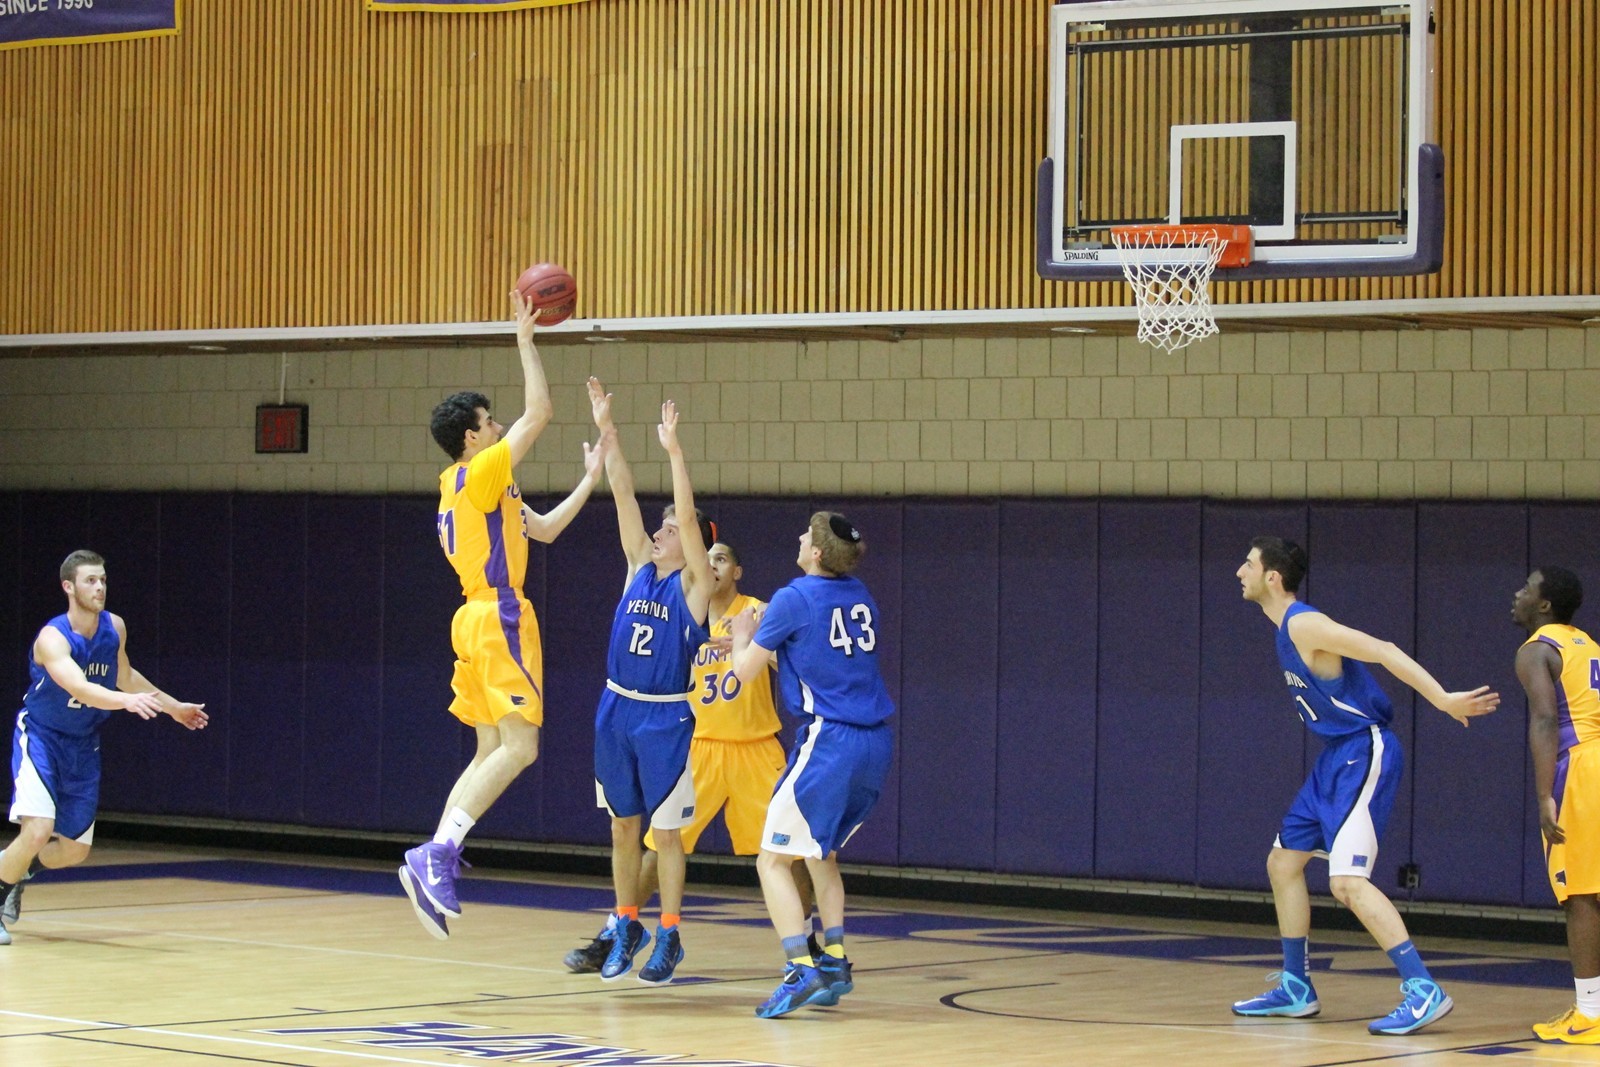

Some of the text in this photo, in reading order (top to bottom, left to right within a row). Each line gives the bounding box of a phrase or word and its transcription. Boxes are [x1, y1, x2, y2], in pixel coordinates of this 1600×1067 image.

[0, 0, 48, 16] SINCE
[1064, 250, 1099, 261] SPALDING
[629, 622, 654, 656] 12
[829, 603, 876, 656] 43
[700, 668, 742, 705] 30
